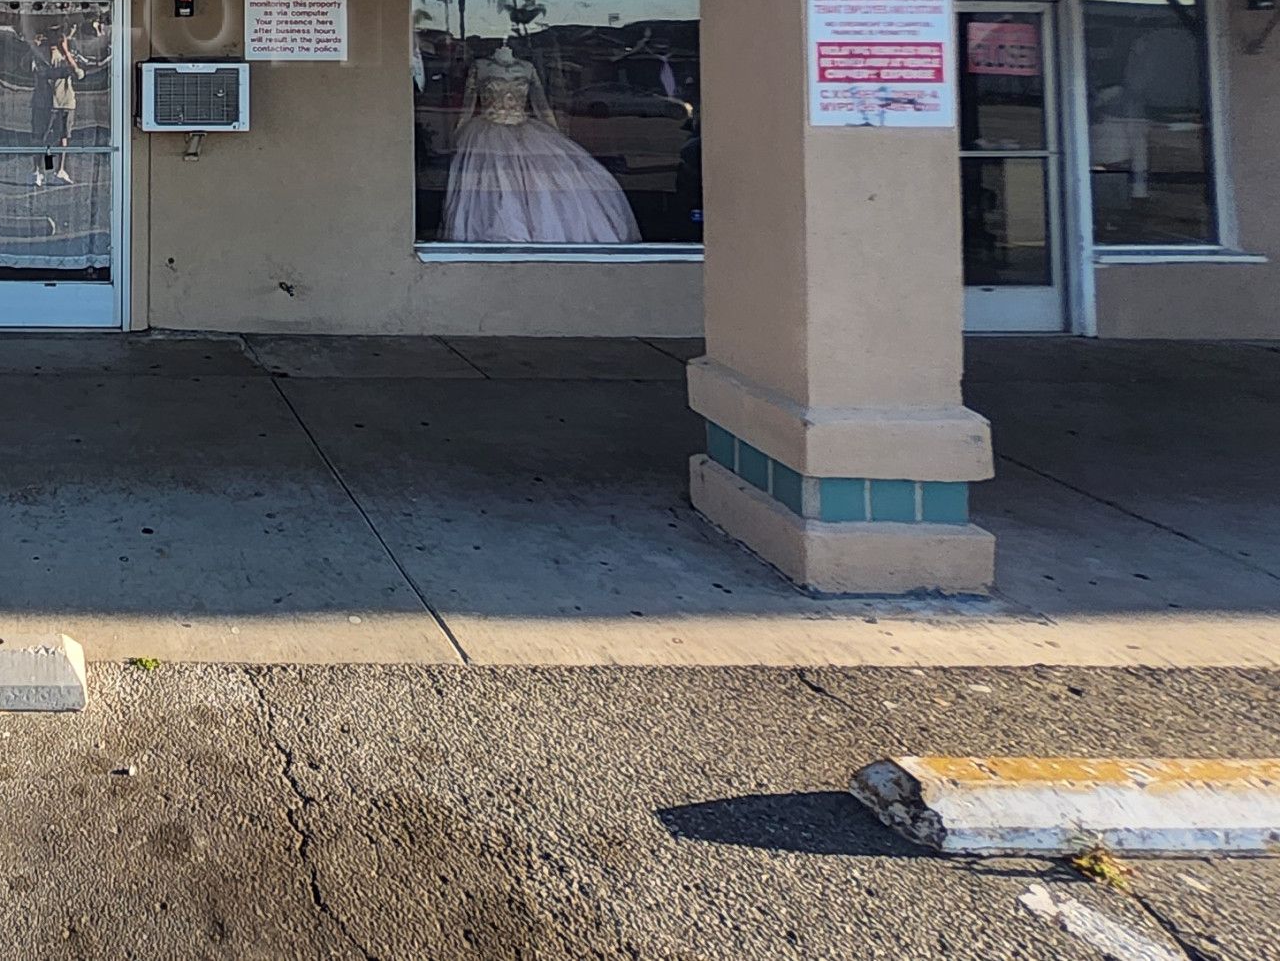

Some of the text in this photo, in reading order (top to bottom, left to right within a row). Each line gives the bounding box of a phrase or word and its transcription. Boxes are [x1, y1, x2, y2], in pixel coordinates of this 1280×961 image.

[249, 1, 291, 9] monitoring
[255, 18, 334, 27] Your presence here
[252, 45, 295, 53] contacting
